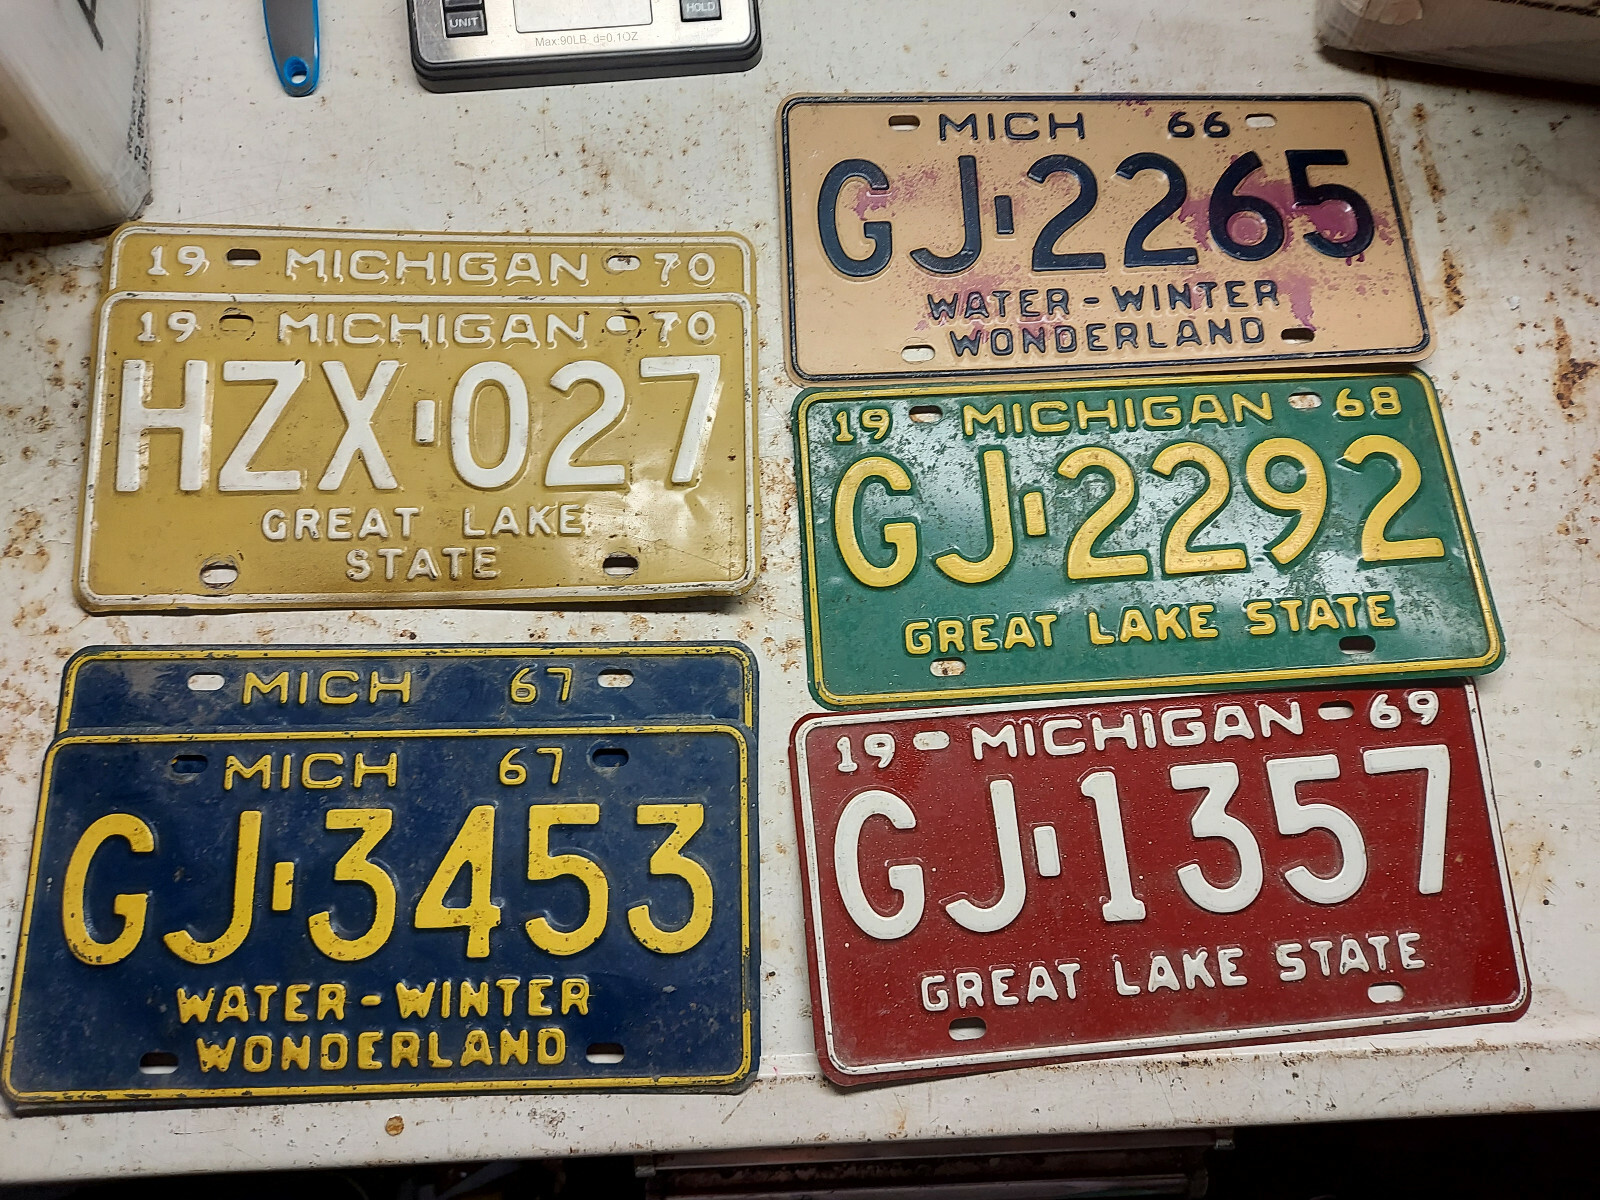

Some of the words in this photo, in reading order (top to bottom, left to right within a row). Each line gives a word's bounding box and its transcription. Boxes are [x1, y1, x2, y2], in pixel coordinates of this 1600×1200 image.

[449, 16, 478, 28] UNIT
[687, 1, 716, 13] HOLD
[535, 34, 587, 47] Max:90LB
[939, 113, 1086, 143] MICH
[1167, 112, 1230, 138] 66
[817, 149, 1374, 278] GJ-2265
[147, 246, 207, 275] 19
[286, 249, 588, 284] MICHIGAN
[655, 253, 716, 286] 70
[928, 288, 1070, 321] WATER
[1113, 280, 1279, 314] WINTER
[138, 312, 199, 343] 19
[279, 313, 586, 346] MICHIGAN
[654, 311, 715, 343] 70
[951, 317, 1264, 357] WONDERLAND
[115, 355, 720, 492] HZX-027
[835, 409, 890, 443] 19
[963, 393, 1273, 438] MICHIGAN
[1337, 386, 1401, 417] 68
[261, 507, 420, 541] GREAT
[464, 505, 586, 537] LAKE
[836, 435, 1444, 587] GJ-2292
[346, 547, 499, 581] STATE
[905, 613, 1059, 655] GREAT
[1089, 602, 1212, 645] LAKE
[1246, 595, 1396, 635] STATE
[243, 670, 411, 705] MICH
[509, 667, 573, 704] 67
[837, 734, 894, 772] 19
[973, 701, 1303, 760] MICHIGAN
[1370, 692, 1438, 729] 69
[224, 754, 397, 790] MICH
[500, 748, 562, 786] 67
[834, 744, 1450, 939] GJ-1357
[62, 803, 714, 966] GJ-3453
[921, 962, 1082, 1011] GREAT
[1114, 947, 1247, 995] LAKE
[1277, 932, 1425, 981] STATE
[177, 983, 347, 1023] WATER
[397, 977, 590, 1019] WINTER
[197, 1027, 567, 1072] WONDERLAND
